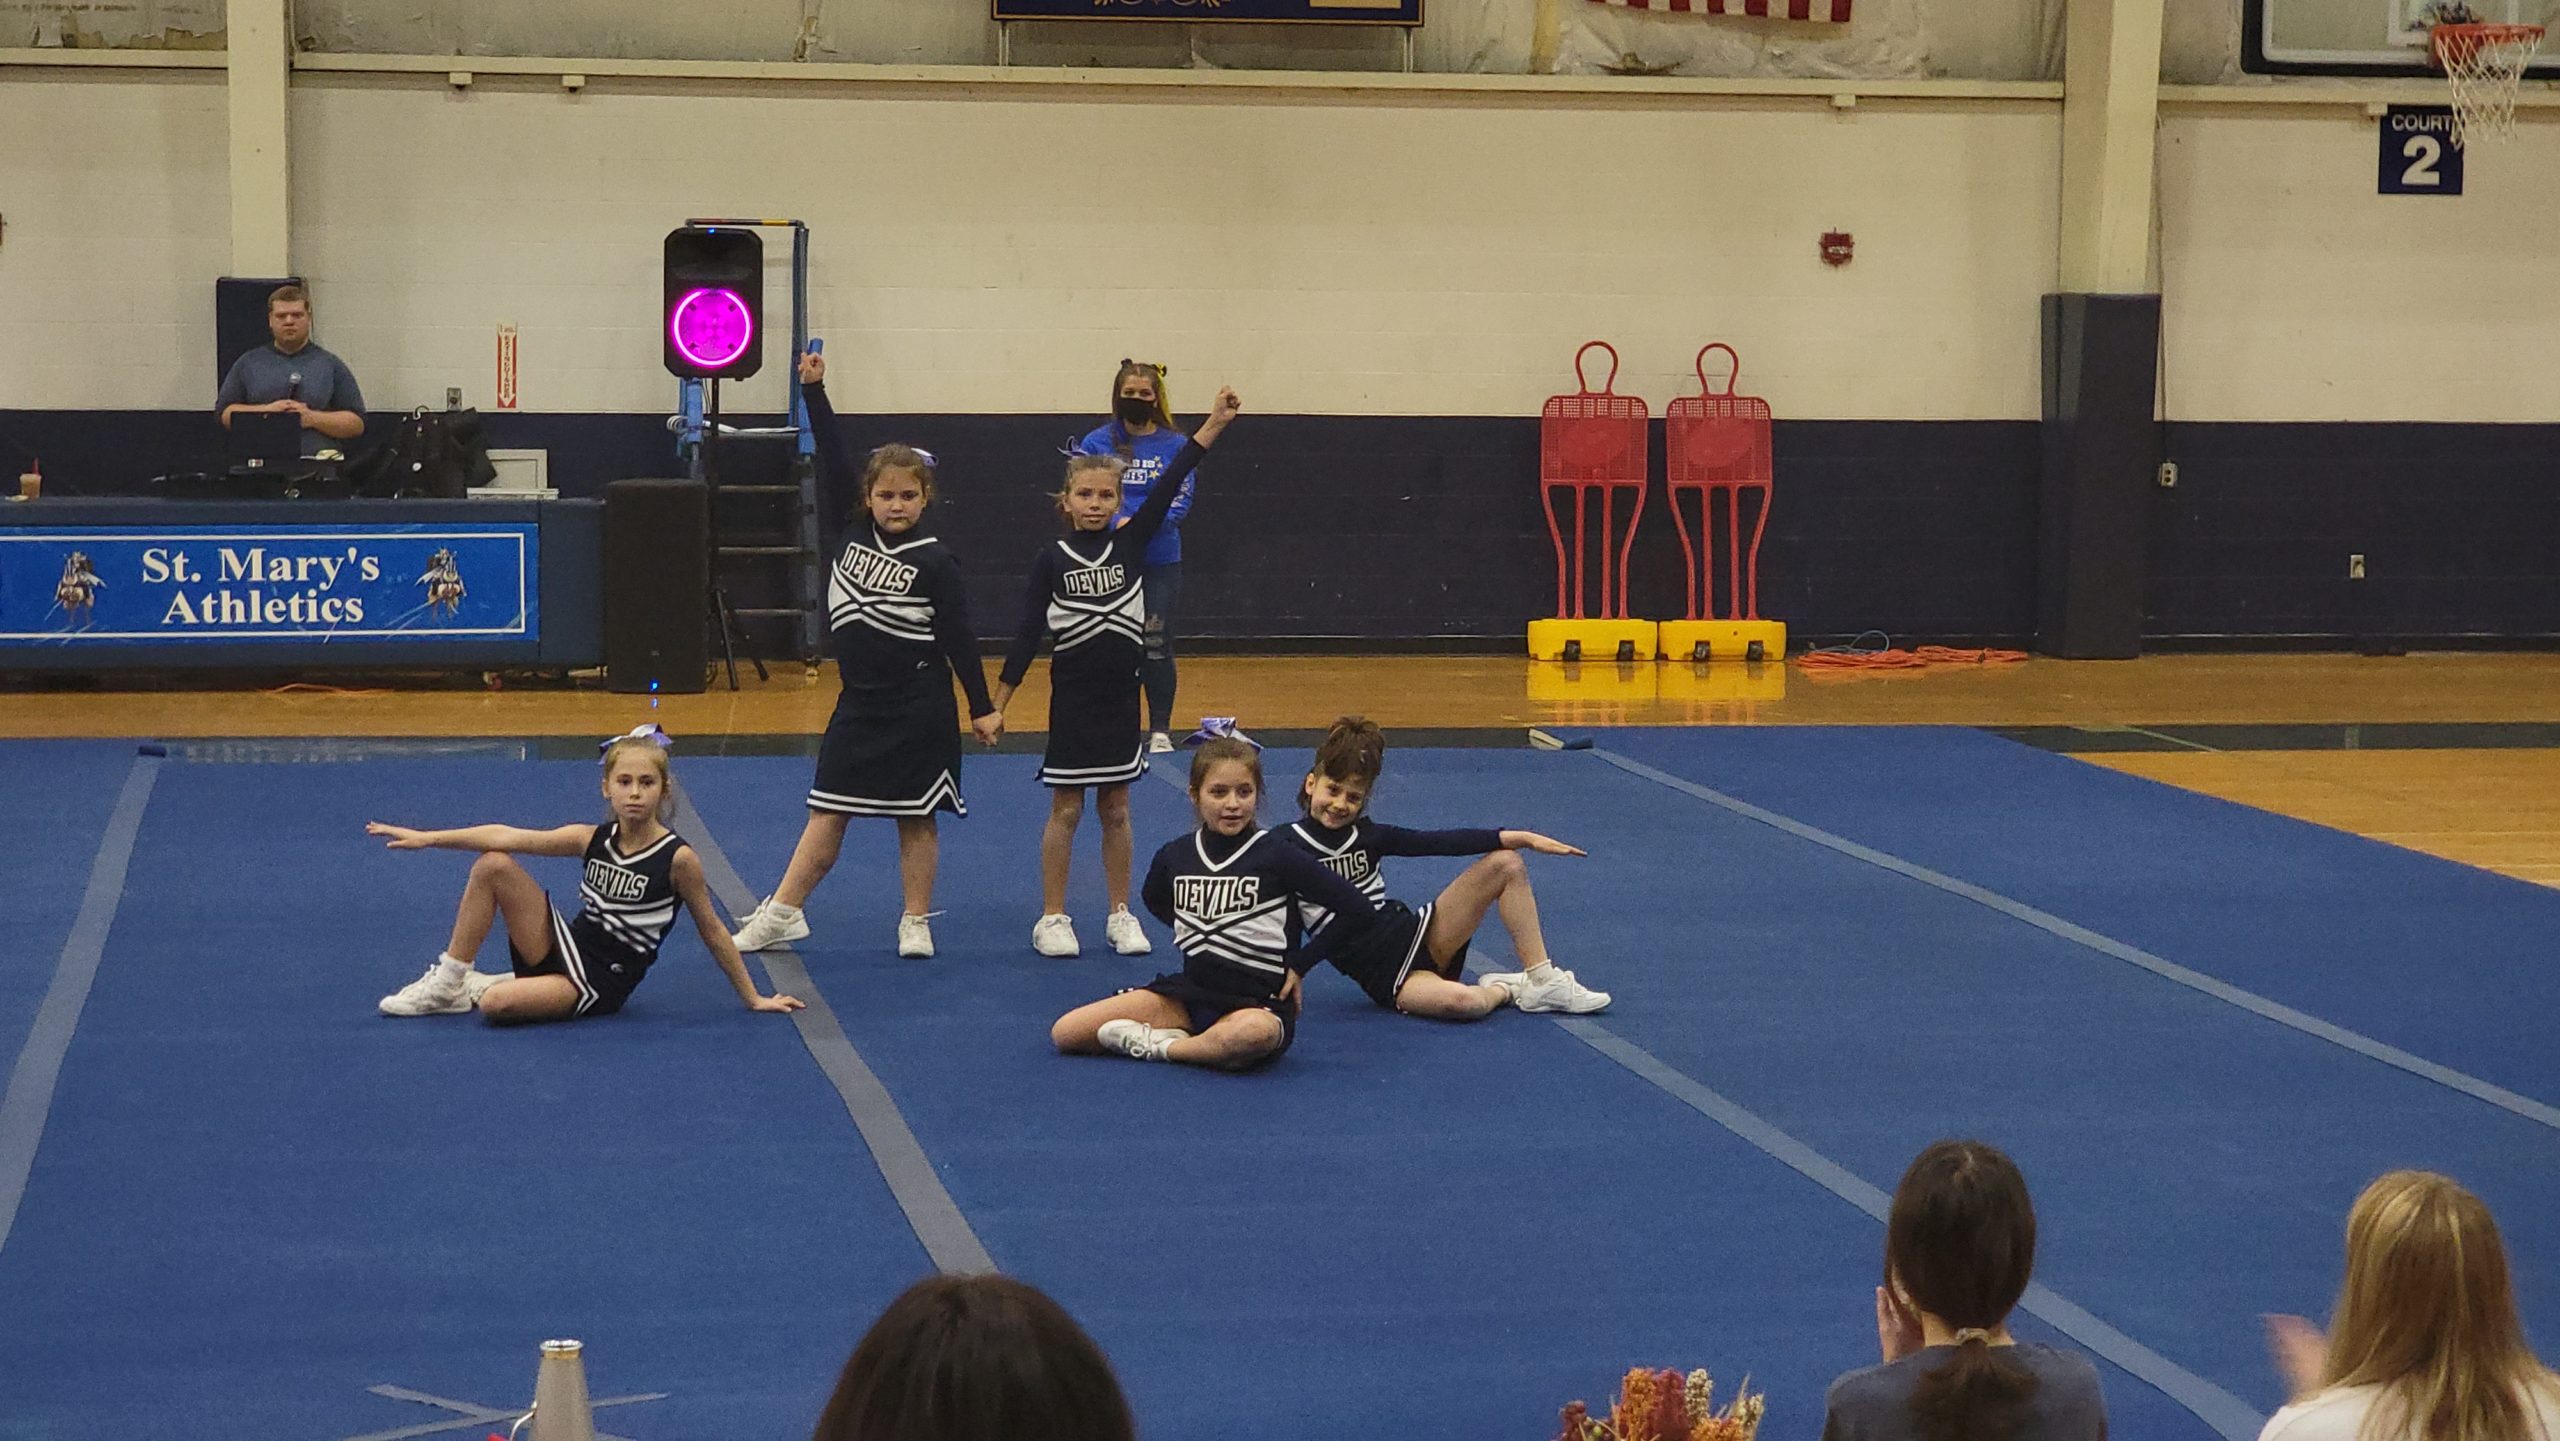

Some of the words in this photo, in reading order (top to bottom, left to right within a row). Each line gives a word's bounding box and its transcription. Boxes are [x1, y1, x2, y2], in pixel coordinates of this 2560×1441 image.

[2391, 113, 2452, 132] COURT
[2401, 134, 2441, 186] 2
[143, 548, 202, 583] St.
[217, 547, 380, 591] Mary's
[840, 541, 919, 595] DEVILS
[1063, 564, 1126, 597] DEVILS
[162, 588, 364, 625] Athletics
[585, 858, 650, 902] DEVILS
[1174, 875, 1260, 920] DEVILS
